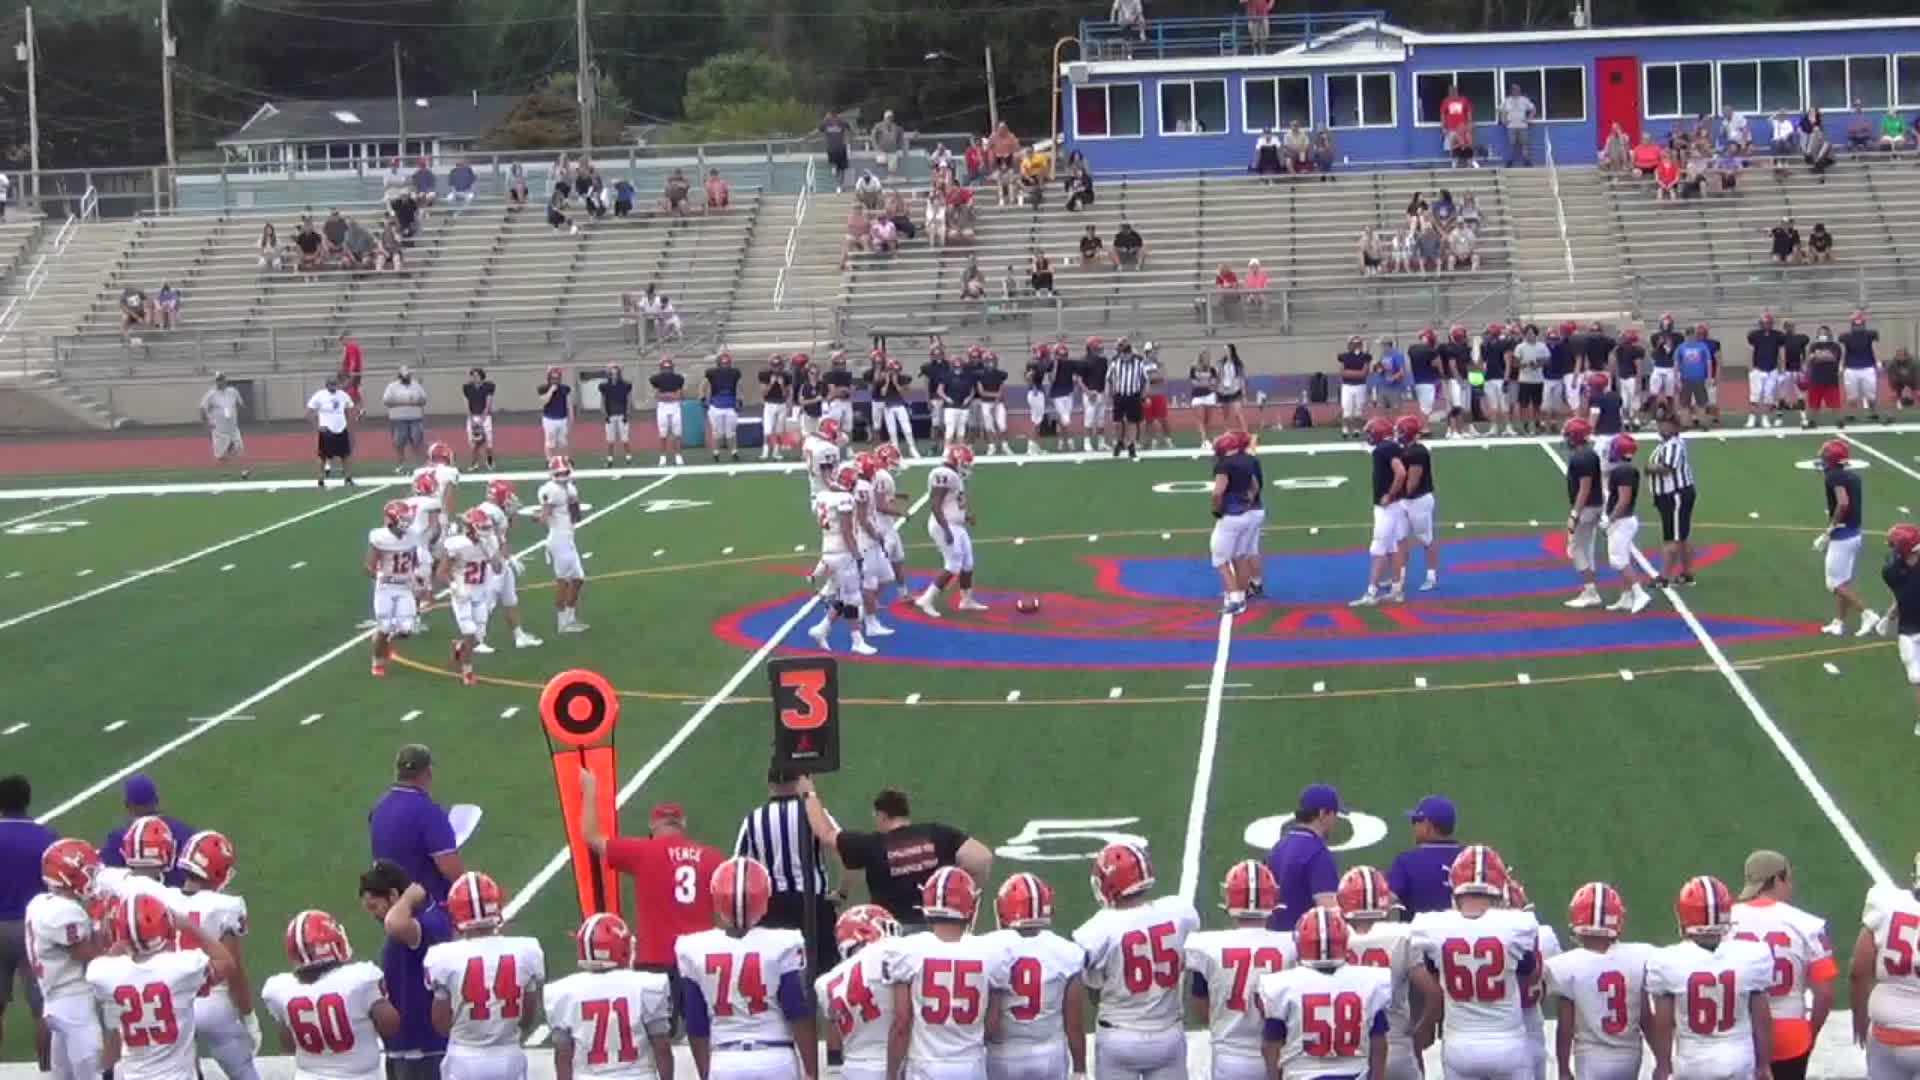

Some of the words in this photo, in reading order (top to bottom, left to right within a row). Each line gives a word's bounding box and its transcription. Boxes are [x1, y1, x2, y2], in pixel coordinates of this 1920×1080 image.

[780, 670, 828, 730] 3
[674, 866, 697, 904] 3
[1122, 921, 1178, 993] 65
[1443, 938, 1505, 1002] 62
[1734, 931, 1794, 997] 6
[1883, 911, 1920, 978] 5
[114, 983, 178, 1047] 23
[462, 957, 521, 1019] 44
[706, 952, 767, 1016] 74
[827, 961, 881, 1036] 54
[921, 958, 983, 1024] 55
[1010, 957, 1042, 1020] 9
[1597, 971, 1627, 1034] 3
[1687, 970, 1736, 1034] 61
[287, 992, 355, 1055] 60
[581, 1000, 638, 1064] 71
[1302, 992, 1362, 1057] 58
